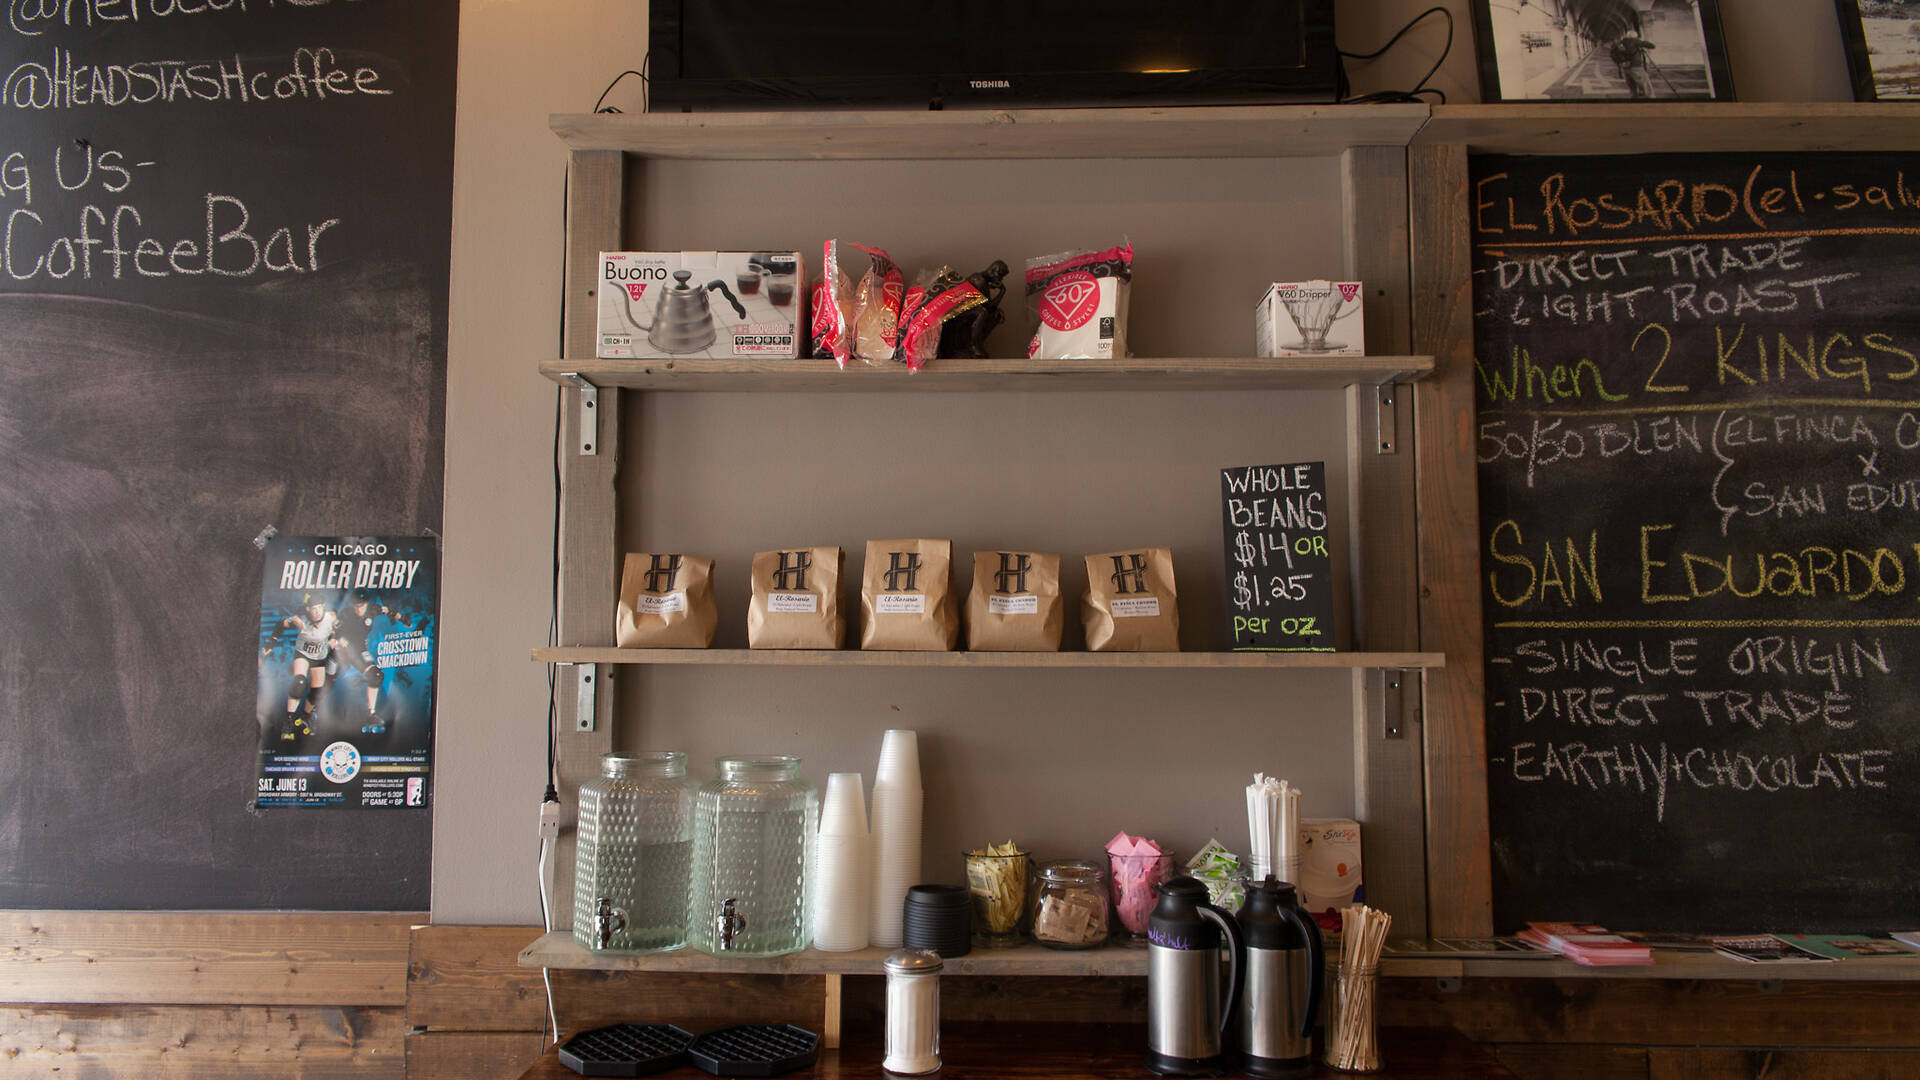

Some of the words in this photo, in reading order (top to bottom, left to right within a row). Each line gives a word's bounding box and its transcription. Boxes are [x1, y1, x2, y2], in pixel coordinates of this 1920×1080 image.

[969, 80, 1011, 88] TOSHIBA
[0, 193, 340, 280] CoffeeBar
[605, 261, 667, 280] Buono
[1493, 249, 1639, 289] DIRECT
[1652, 236, 1812, 279] TRADE
[1278, 290, 1297, 299] V60
[1299, 290, 1331, 300] Dripper
[1343, 285, 1355, 294] 02
[1511, 285, 1655, 326] LIGHT
[1663, 272, 1861, 322] ROAST
[1473, 344, 1629, 403] When
[1631, 323, 1689, 392] 2
[1715, 323, 1920, 393] KINGS
[1223, 464, 1312, 494] WHOLE
[1228, 492, 1328, 531] BEANS
[1744, 482, 1827, 518] SAN
[313, 544, 388, 556] CHICAGO
[1234, 530, 1294, 569] $14
[1294, 535, 1329, 558] OR
[1490, 519, 1603, 608] SAN
[280, 560, 353, 590] ROLLER
[354, 560, 421, 589] DERBY
[643, 553, 684, 593] H
[772, 551, 813, 591] H
[883, 552, 923, 592] H
[994, 552, 1032, 594] H
[1110, 553, 1148, 594] H
[1233, 570, 1314, 612] $1.25
[377, 637, 429, 656] CROSSTOWN
[1233, 615, 1271, 642] per
[376, 651, 428, 669] SMACKDOWN
[1516, 637, 1699, 684] SINGLE
[1728, 635, 1891, 690] ORIGIN
[1519, 687, 1669, 727] DIRECT
[1683, 688, 1858, 730] TRADE
[258, 778, 275, 792] SAT.
[276, 778, 298, 792] JUNE
[298, 778, 307, 792] 13
[370, 798, 388, 806] GAME
